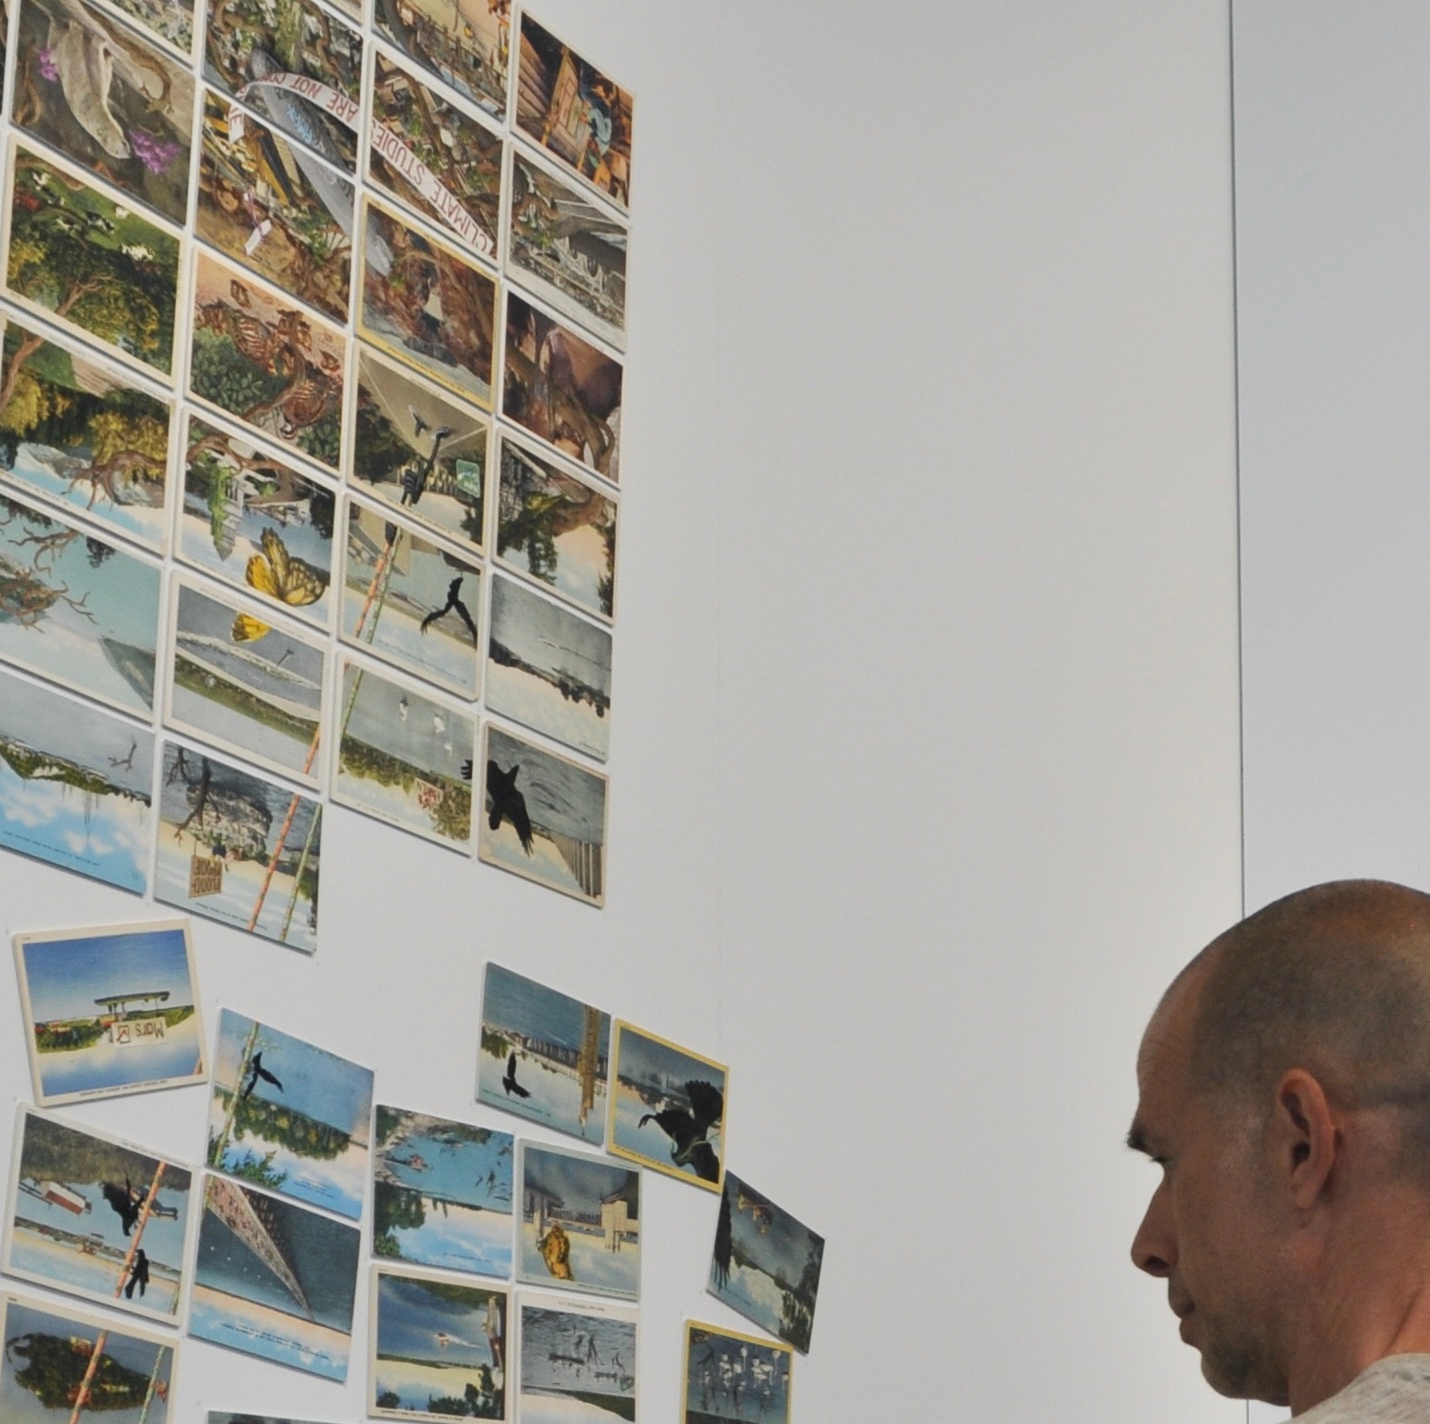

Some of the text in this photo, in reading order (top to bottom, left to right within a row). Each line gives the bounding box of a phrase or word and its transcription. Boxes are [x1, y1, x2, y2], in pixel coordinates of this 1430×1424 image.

[290, 77, 322, 101] NOT
[327, 91, 360, 122] ARE
[430, 179, 490, 252] CLIMATE
[134, 1020, 166, 1039] Mars
